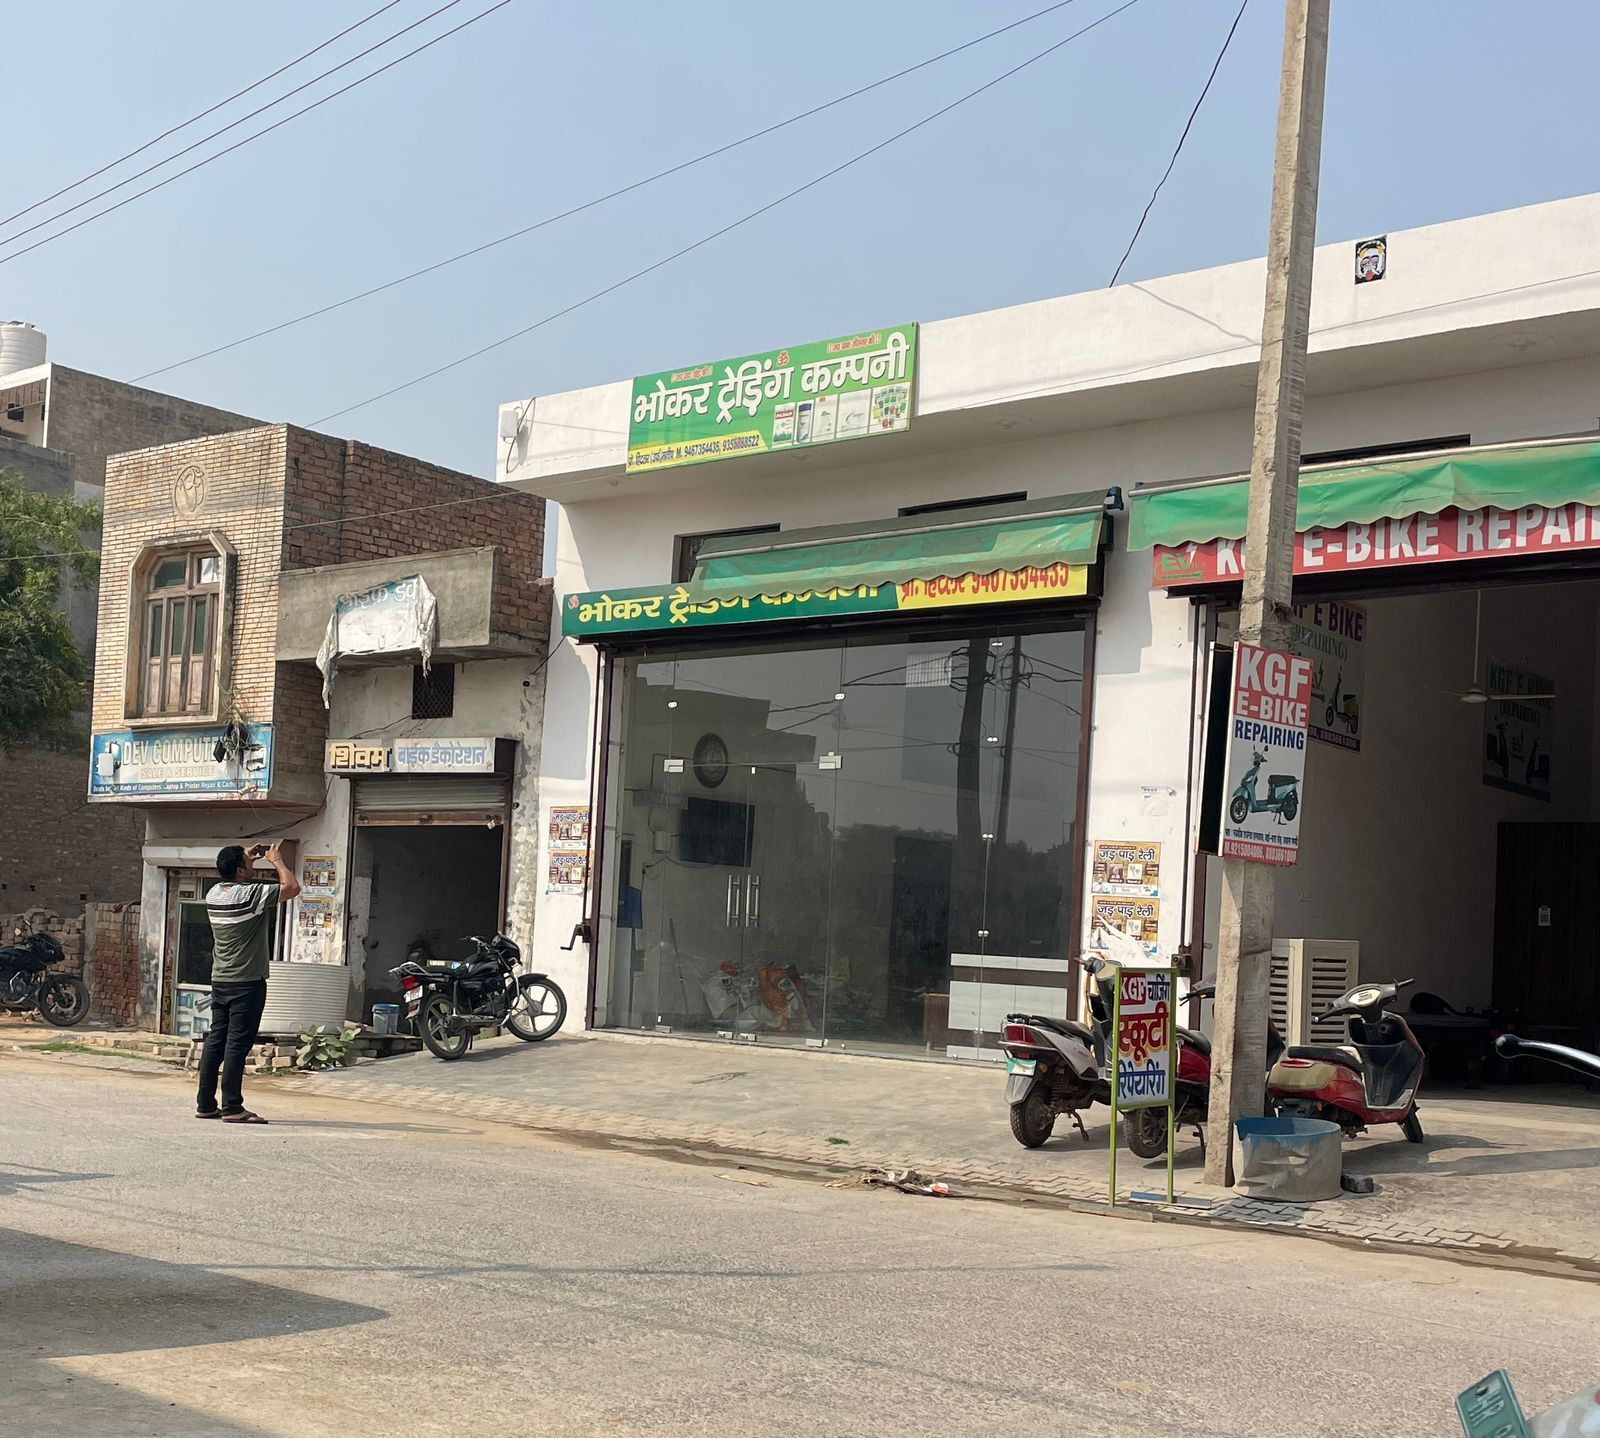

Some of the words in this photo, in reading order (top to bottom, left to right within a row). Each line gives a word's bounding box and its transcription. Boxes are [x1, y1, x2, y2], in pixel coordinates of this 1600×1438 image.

[633, 378, 713, 424] भोकर
[715, 359, 795, 424] ट्रेडिंग
[801, 332, 910, 394] कम्पनी
[1456, 502, 1600, 553] REPAI
[578, 593, 664, 623] भोकर
[1240, 647, 1310, 699] KGF
[1236, 690, 1307, 727] E-BIKE
[1235, 719, 1304, 750] REPAIRING
[123, 740, 149, 766] DEV
[141, 767, 164, 779] SALE
[175, 765, 216, 778] SERVICE
[1120, 976, 1146, 1001] KGF
[1119, 1001, 1169, 1061] स्कूटी
